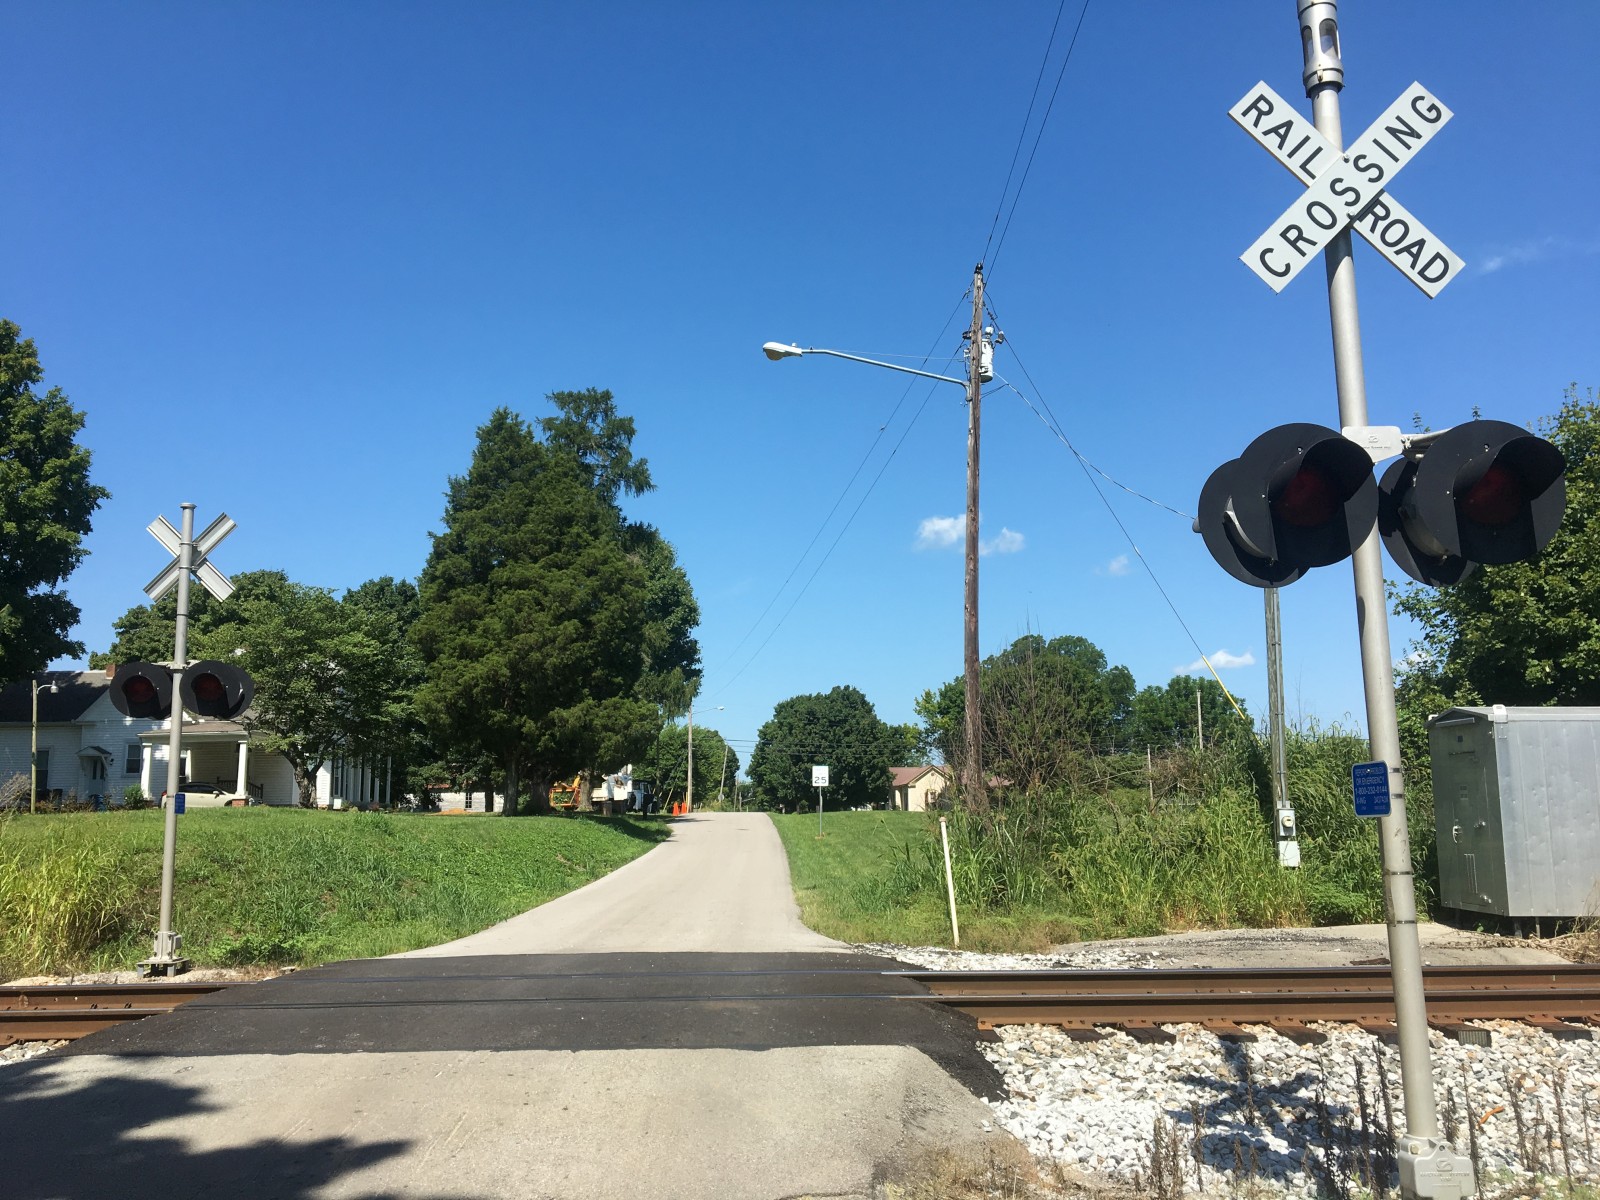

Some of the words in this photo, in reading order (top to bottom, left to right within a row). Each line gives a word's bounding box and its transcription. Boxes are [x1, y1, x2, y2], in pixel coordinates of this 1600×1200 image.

[1241, 93, 1323, 180] RAIL
[1358, 198, 1450, 283] ROAD
[1259, 95, 1442, 278] CROSSING
[814, 776, 827, 784] 25
